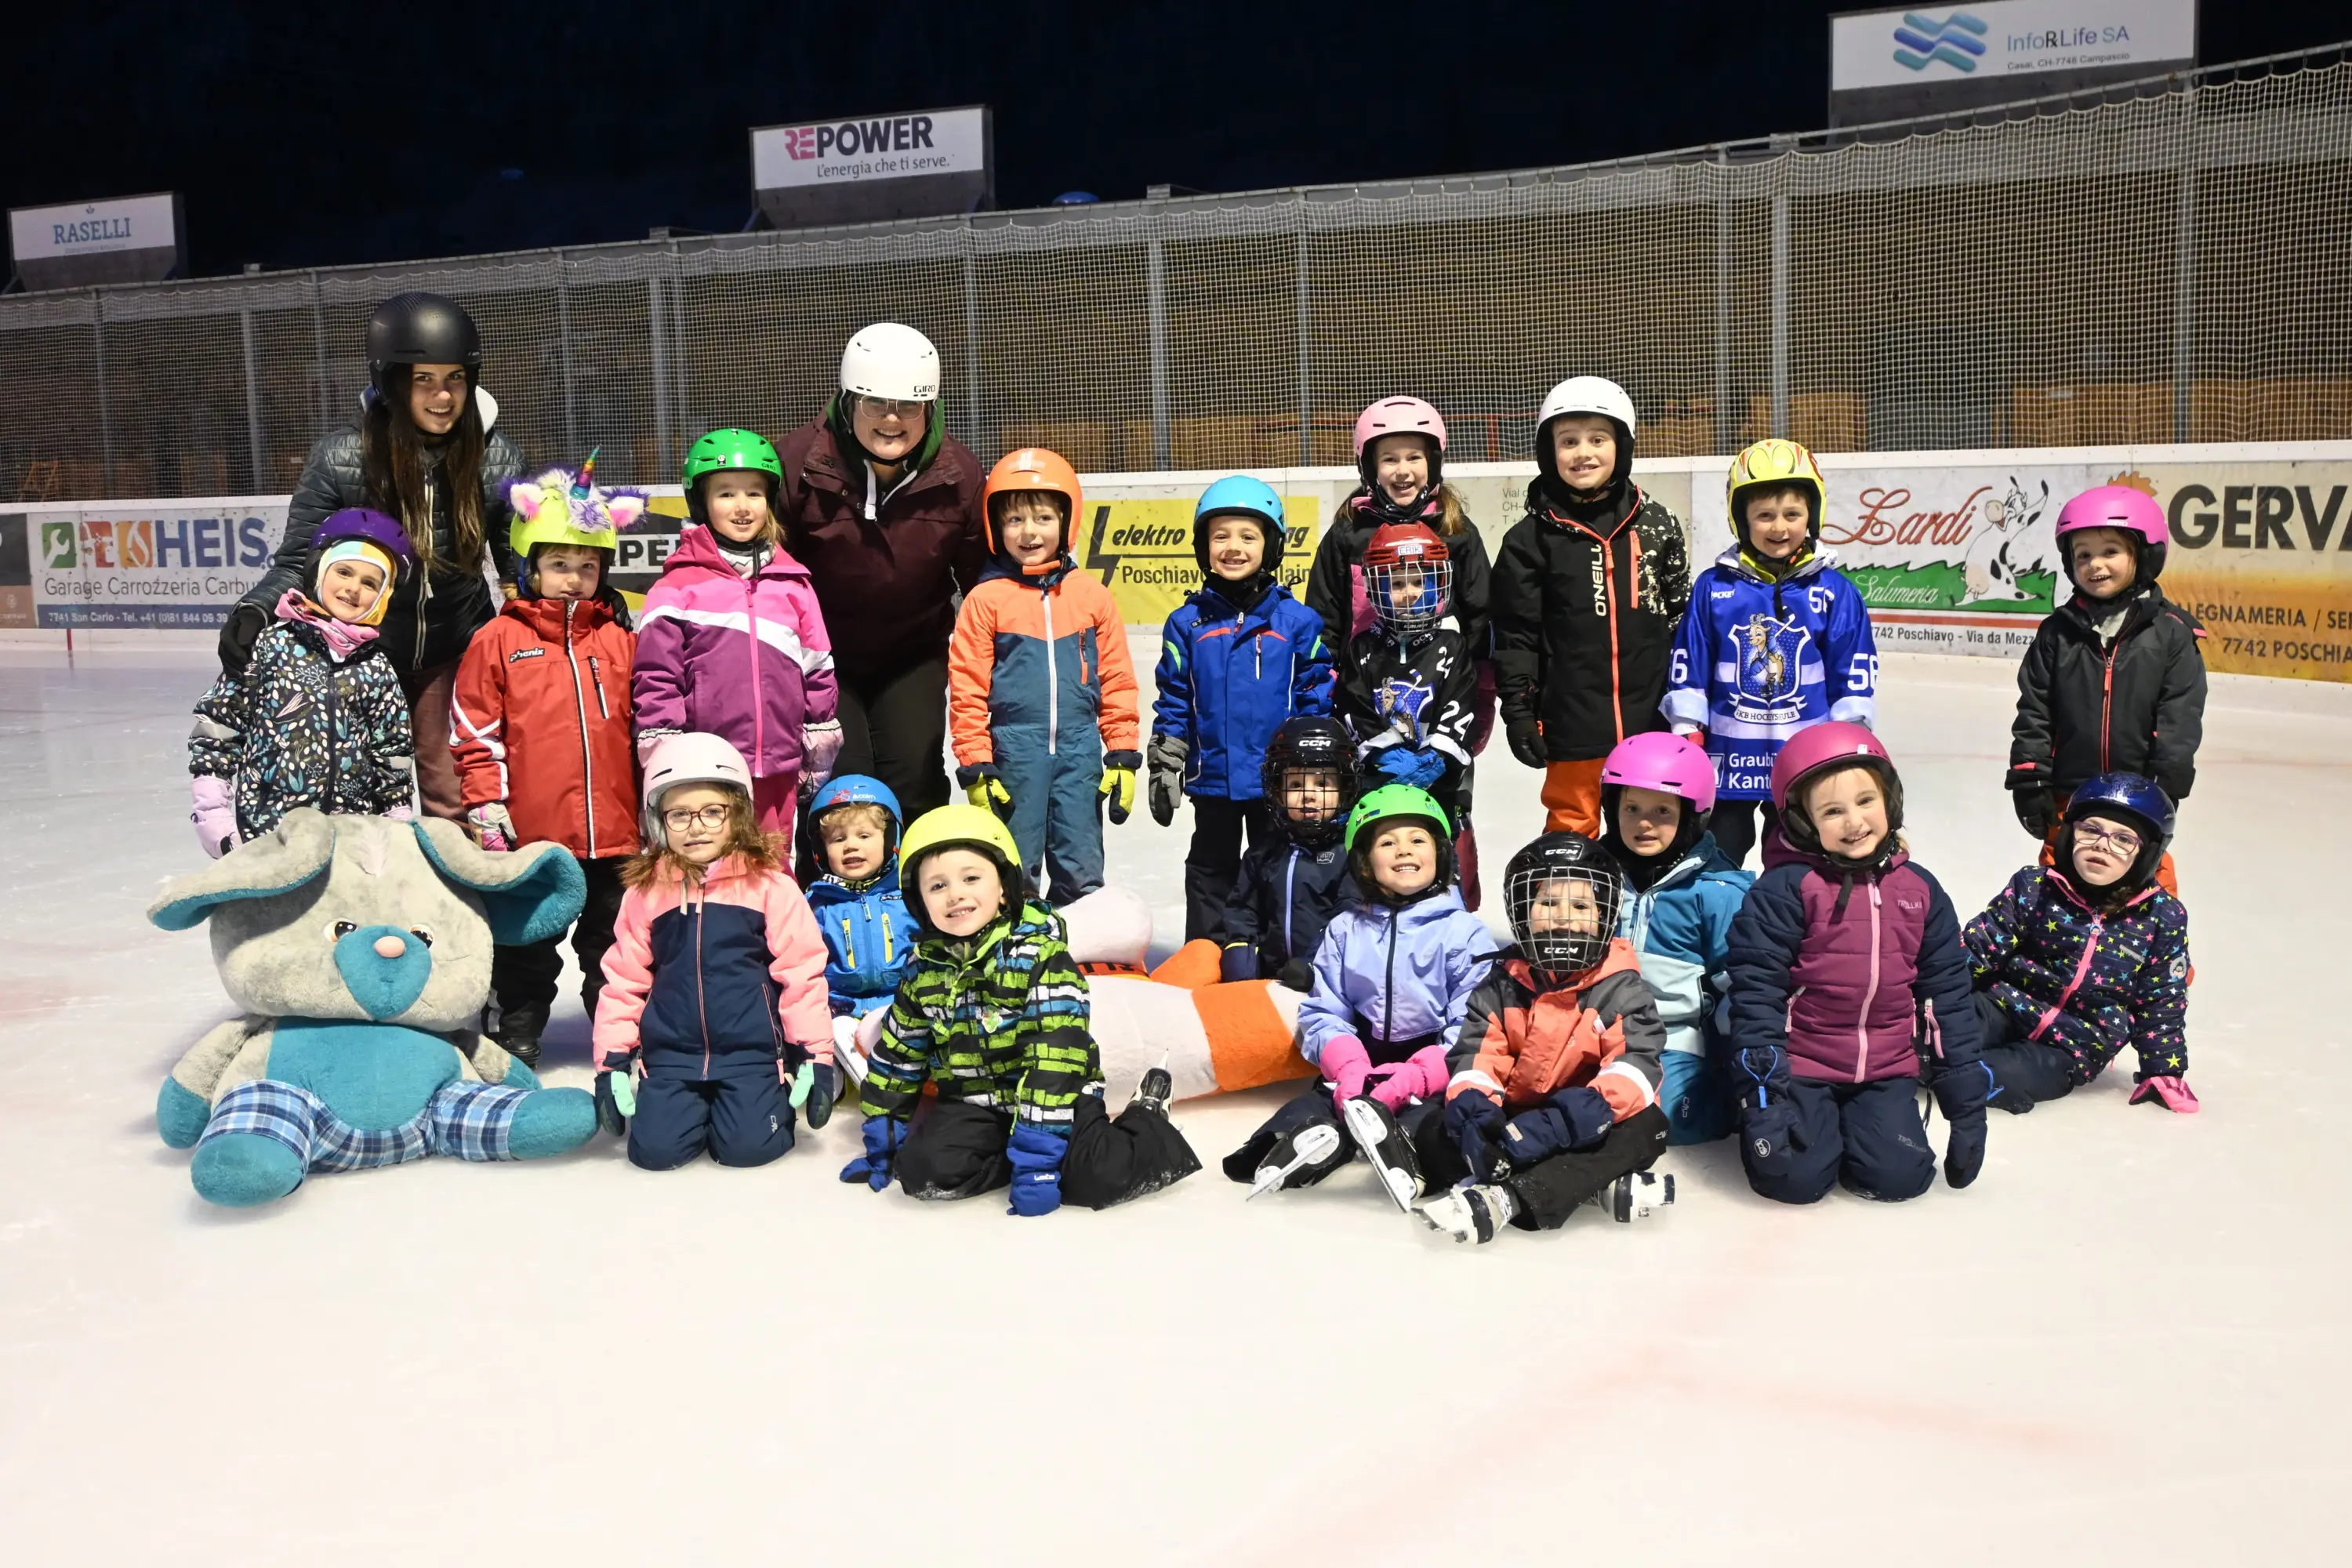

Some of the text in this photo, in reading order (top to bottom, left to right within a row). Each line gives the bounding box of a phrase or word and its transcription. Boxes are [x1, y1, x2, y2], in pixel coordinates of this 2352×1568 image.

[2102, 25, 2130, 43] SA
[2079, 52, 2130, 64] Campascio
[784, 116, 934, 160] REPOWER
[875, 158, 897, 172] che
[900, 156, 909, 170] ti
[913, 154, 950, 169] serve.
[53, 217, 132, 245] RASELLI
[913, 384, 936, 393] GIRO
[1502, 488, 1519, 498] Vial
[1502, 515, 1509, 524] T
[1819, 485, 1993, 546] Lardi
[1112, 524, 1186, 546] elektro
[1398, 545, 1421, 556] ERIK
[45, 576, 103, 601] Garage
[107, 576, 201, 597] Carrozzeria
[1854, 574, 1940, 605] Salumeria
[183, 612, 200, 623] 844
[202, 612, 214, 623] 09
[216, 612, 228, 623] 39
[1871, 626, 1894, 639] 742
[1896, 627, 1954, 642] Poschiavo
[1966, 630, 1984, 643] Via
[1987, 630, 2002, 644] da
[510, 648, 544, 662] phenix
[2223, 637, 2266, 658] 7742
[1670, 649, 1688, 684] 6
[1436, 700, 1475, 742] 24
[1298, 739, 1331, 747] CCM
